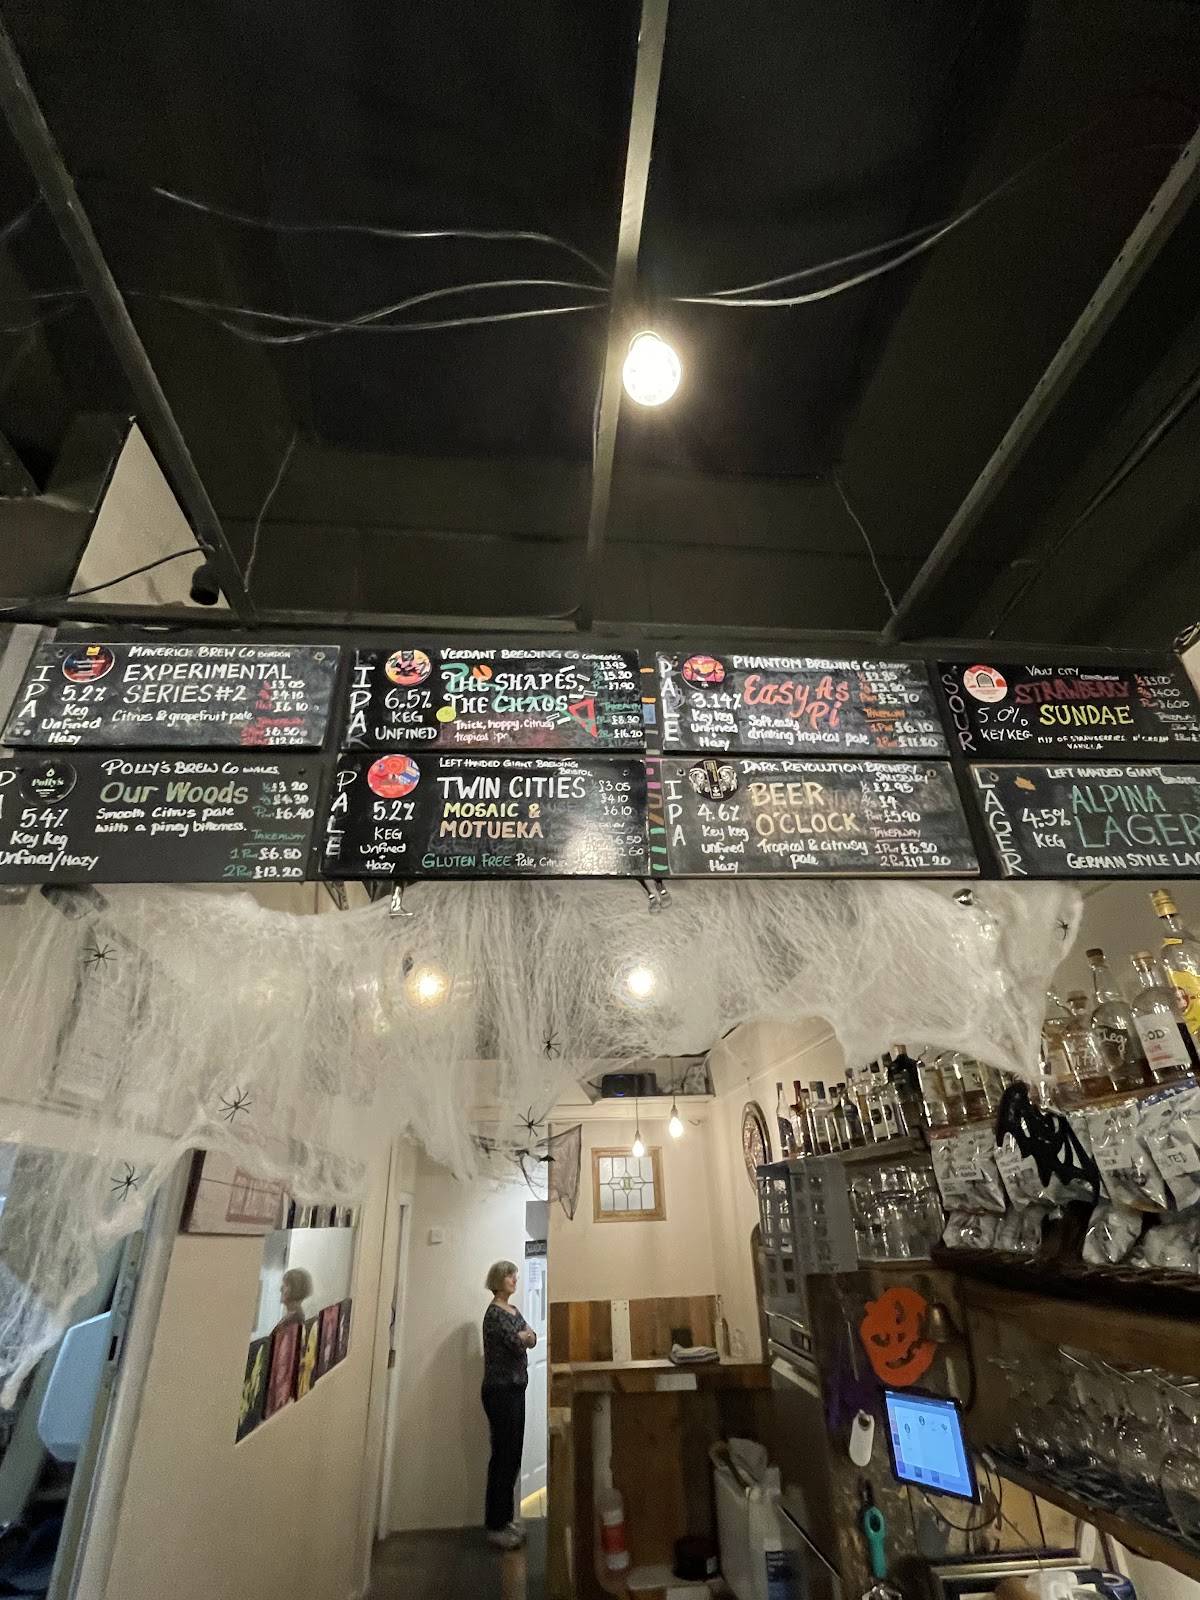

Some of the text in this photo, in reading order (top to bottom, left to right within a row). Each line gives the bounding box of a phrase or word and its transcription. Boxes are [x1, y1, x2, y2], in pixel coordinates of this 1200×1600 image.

[128, 646, 193, 657] MAVERICK
[198, 646, 236, 657] BREW
[440, 648, 496, 659] VERDANT
[501, 650, 561, 659] BREWING
[733, 656, 801, 669] PHANTOM
[805, 658, 860, 670] BREWING
[123, 663, 292, 682] EXPERIMENTAL
[18, 665, 55, 718] IPA
[349, 666, 375, 734] IPA
[385, 688, 432, 709] 6.5%
[660, 659, 680, 741] PALE
[744, 675, 849, 718] Easy As
[1015, 679, 1129, 704] STRAWBERRY
[494, 695, 568, 713] CHAOS
[691, 692, 742, 710] 3.14%
[62, 704, 88, 719] Keg
[112, 710, 153, 721] Citrus
[156, 710, 167, 721] &
[168, 710, 228, 727] grapefruit
[229, 711, 254, 724] pale
[392, 711, 423, 723] KEG
[692, 709, 713, 726] Key
[805, 701, 842, 730] Pi
[942, 674, 976, 751] SOUR
[1040, 704, 1134, 726] SUNDAE
[48, 732, 82, 745] Hazy
[375, 725, 438, 740] UNFINED
[454, 732, 489, 744] tropical
[748, 727, 794, 745] drinking
[797, 732, 840, 744] tropical
[845, 732, 869, 747] pale
[700, 737, 730, 751] Hazy
[101, 759, 171, 776] POLLY'S
[175, 761, 218, 774] BREW
[440, 757, 462, 768] LEFT
[464, 759, 500, 768] HANDED
[503, 760, 533, 768] GIANT
[740, 760, 916, 775] DARK REVOLUTION BREWERY
[1046, 768, 1074, 778] LEFT
[1126, 767, 1161, 777] GIANT
[100, 782, 159, 803] Our
[166, 781, 248, 804] Woods
[437, 776, 586, 799] TWIN CITIES
[748, 781, 824, 806] BEER
[1072, 785, 1166, 814] ALPINA
[20, 808, 69, 828] 5.4%
[96, 807, 234, 821] Smooth Citrus pale
[325, 771, 357, 856] PALE
[373, 800, 415, 821] 5.2%
[443, 802, 541, 819] MOSAIC &
[664, 780, 686, 847] IPA
[697, 803, 739, 822] 4.6%
[1022, 808, 1071, 829] 4.5%
[95, 822, 129, 832] with
[151, 822, 190, 837] piney
[440, 820, 544, 839] MOTUEKA
[755, 812, 860, 836] O'CLOCK
[974, 768, 1027, 876] LAGER
[10, 831, 39, 848] Key
[374, 826, 402, 840] KEG
[701, 825, 724, 840] Key
[1033, 832, 1066, 849] KEG
[360, 843, 406, 854] Unfined
[757, 839, 804, 856] Tropical
[808, 839, 819, 851] &
[365, 860, 395, 873] Hazy
[422, 853, 476, 868] GLUTEN
[482, 853, 512, 867] FREE
[709, 859, 739, 874] Hazy
[790, 853, 819, 869] pale
[1067, 853, 1171, 869] GERMAN STYLE
[253, 866, 303, 879] £13.20
